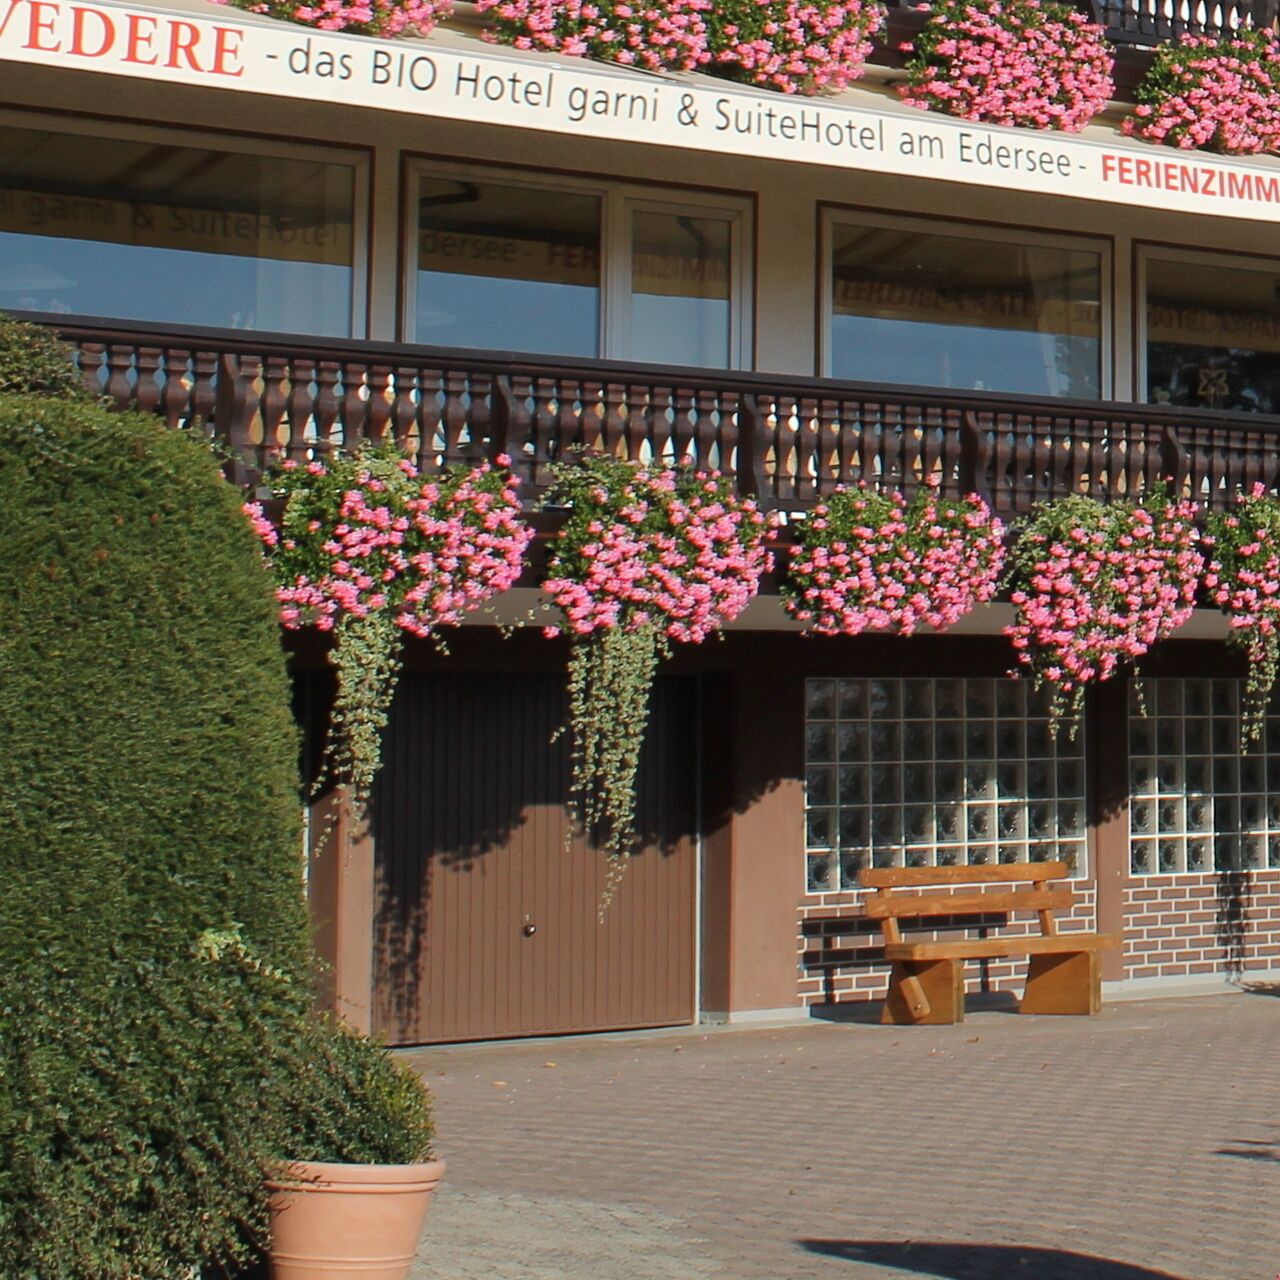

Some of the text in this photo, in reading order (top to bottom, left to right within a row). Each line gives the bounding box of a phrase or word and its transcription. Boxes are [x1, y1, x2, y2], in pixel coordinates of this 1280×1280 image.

[371, 50, 437, 91] BIO
[455, 62, 554, 108] Hotel
[568, 86, 660, 122] garni
[677, 93, 700, 127] &
[715, 98, 885, 152] SuiteHotel
[900, 131, 944, 160] am
